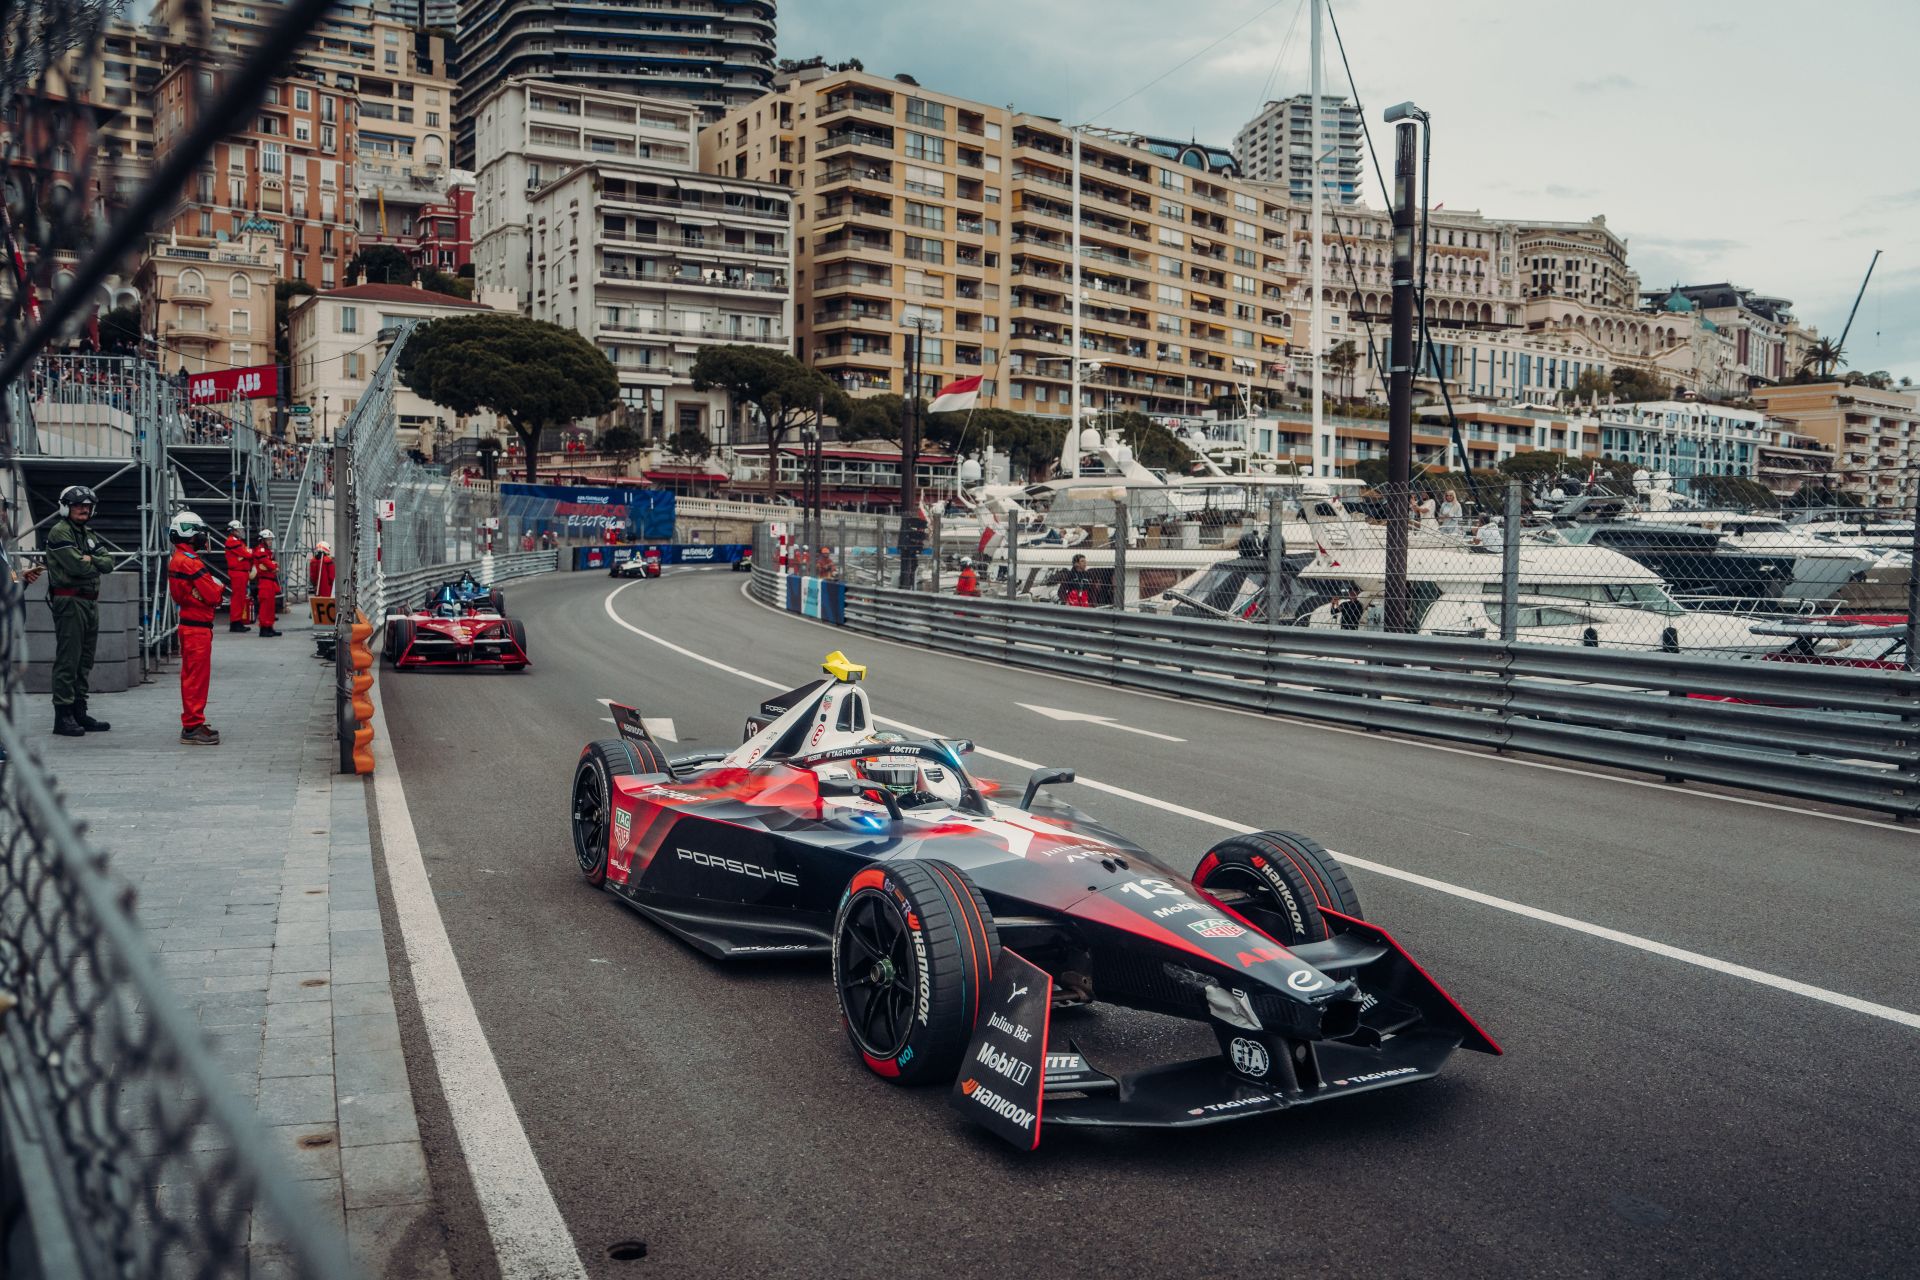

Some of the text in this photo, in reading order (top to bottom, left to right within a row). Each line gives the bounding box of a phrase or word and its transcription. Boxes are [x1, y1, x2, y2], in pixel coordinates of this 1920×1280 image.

[192, 379, 216, 399] ABB
[236, 373, 261, 392] ABB
[567, 514, 617, 528] ELECTRIC
[765, 704, 788, 714] PORSC
[890, 745, 921, 755] LOCTITE
[617, 811, 631, 829] TAG
[676, 848, 800, 887] PORSCHE
[1119, 878, 1186, 900] 13
[987, 1011, 1032, 1043] Julius Bär
[976, 1041, 1019, 1078] Mobil
[1045, 1056, 1080, 1068] TITE
